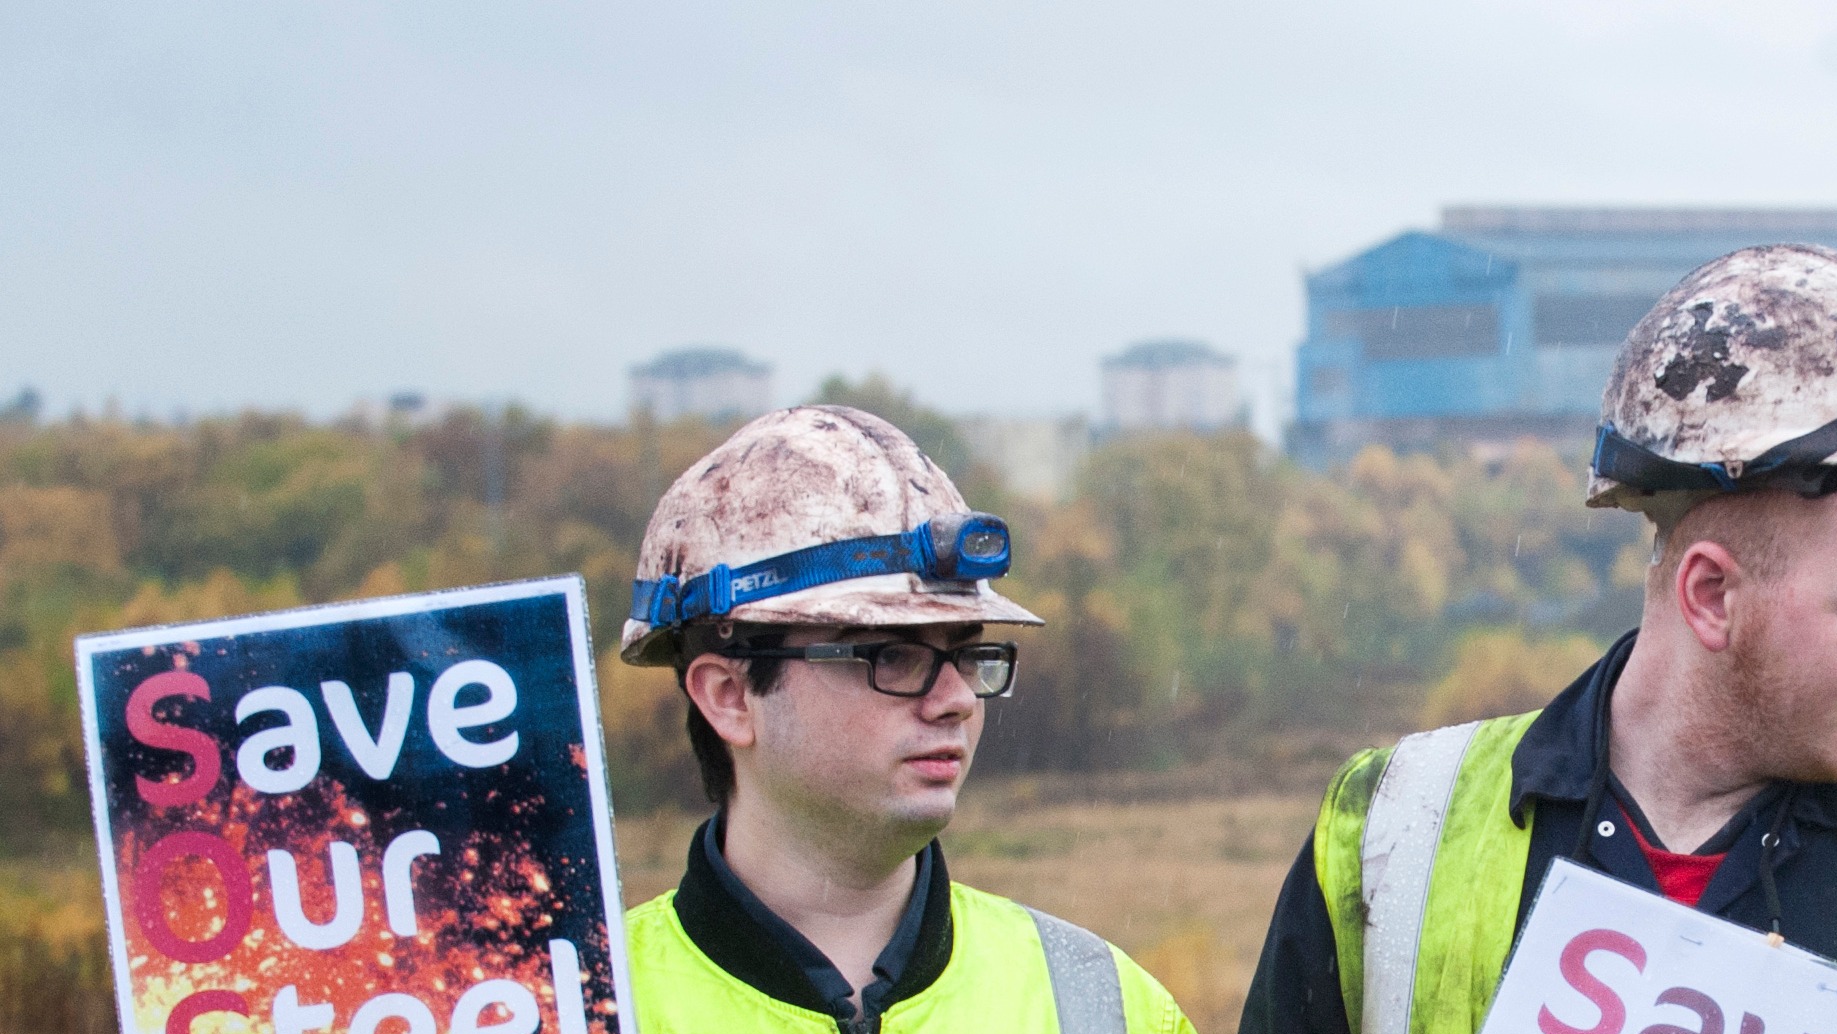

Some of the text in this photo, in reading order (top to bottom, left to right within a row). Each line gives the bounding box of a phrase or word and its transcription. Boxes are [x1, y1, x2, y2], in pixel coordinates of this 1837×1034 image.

[731, 568, 790, 602] PETZL
[125, 659, 519, 806] Save
[136, 829, 440, 964] Our
